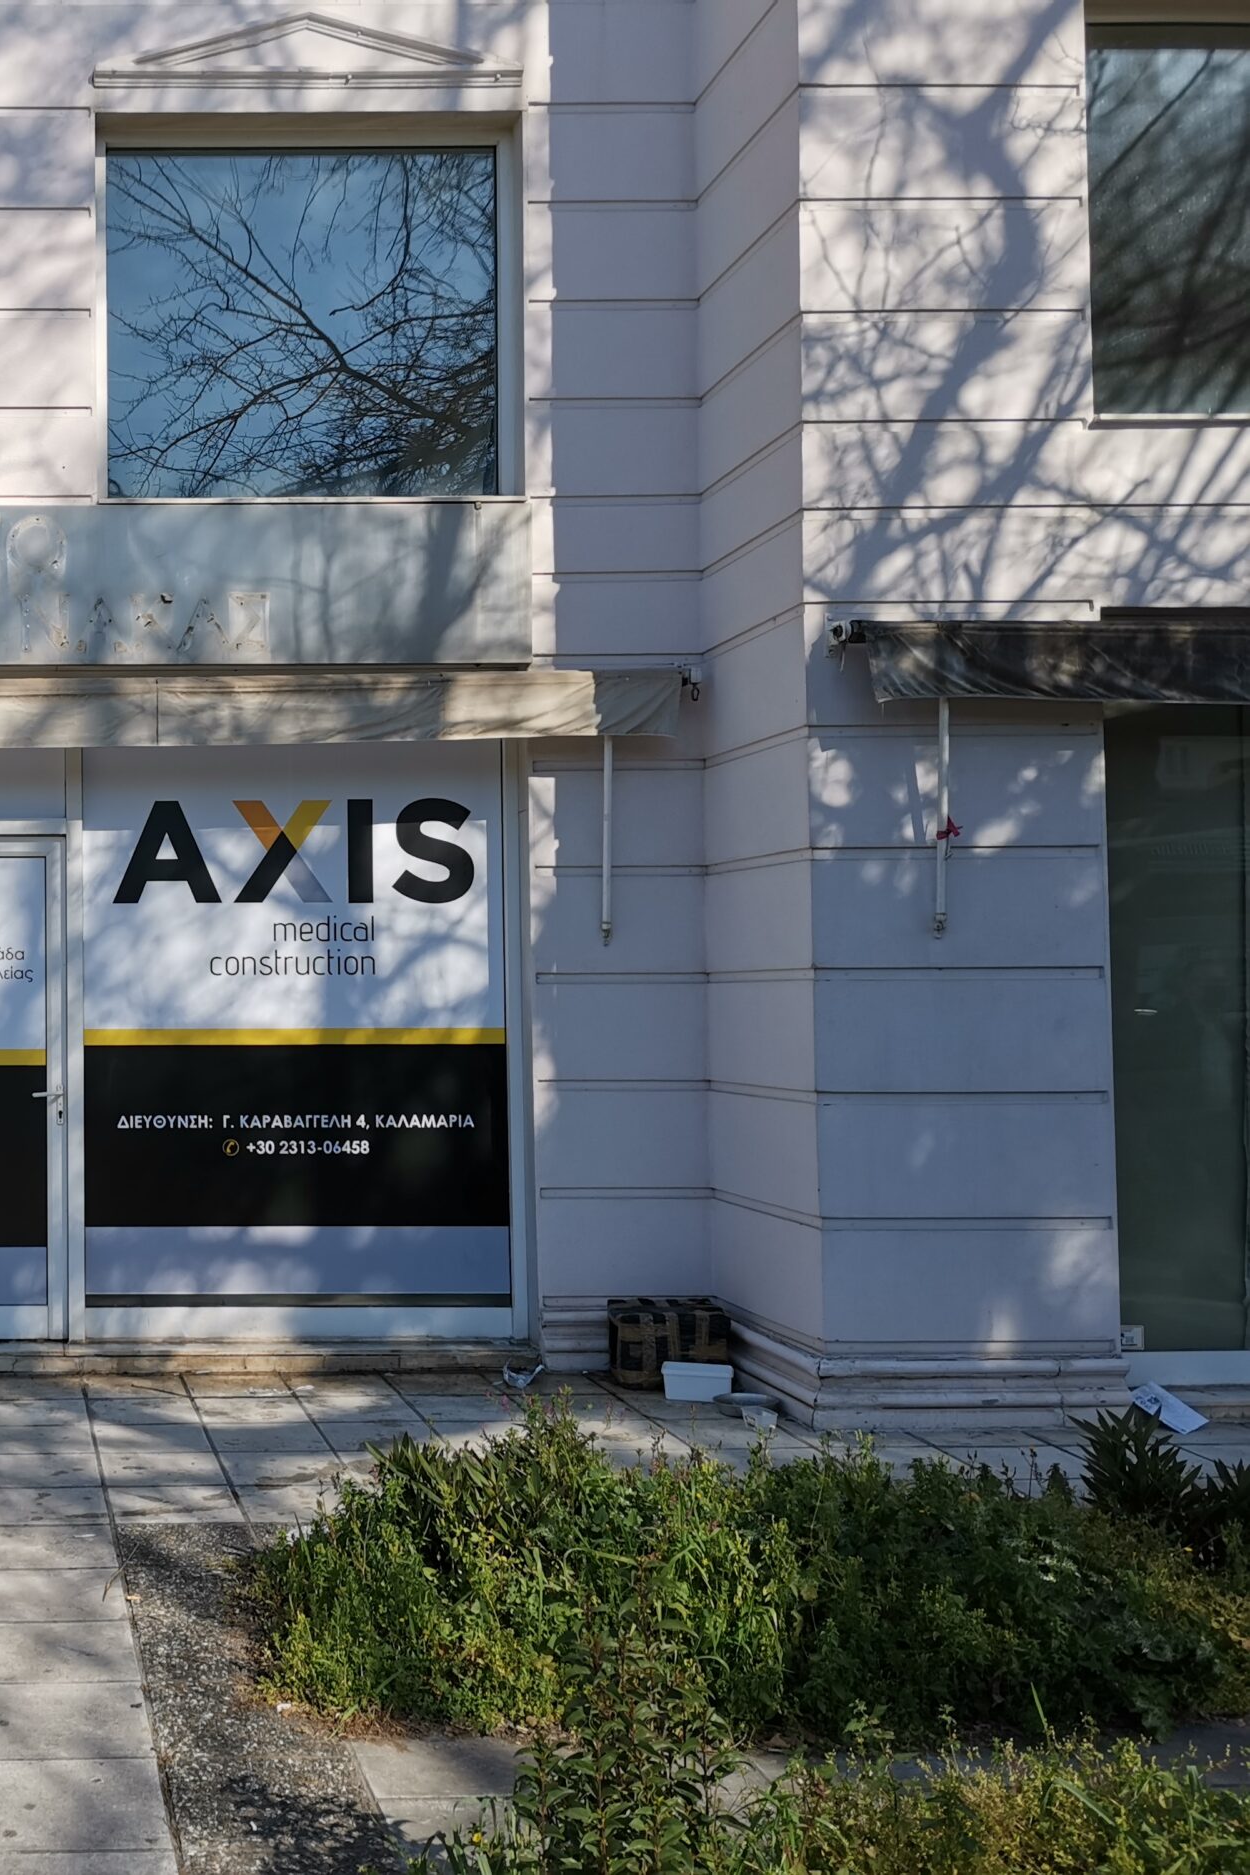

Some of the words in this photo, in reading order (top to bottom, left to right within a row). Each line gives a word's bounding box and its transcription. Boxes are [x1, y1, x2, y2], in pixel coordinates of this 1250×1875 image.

[113, 798, 475, 904] AXIS
[273, 915, 375, 942] medical
[209, 949, 376, 976] construction
[117, 1115, 213, 1129] ΔΙΕΥΘΥΝΣΗ:
[223, 1115, 235, 1129] Γ.
[240, 1114, 351, 1129] ΚΑΡΑΒΑΓΓΕΛΗ
[355, 1114, 370, 1130] 4,
[375, 1114, 475, 1129] ΚΑΛΑΜΑΡΙΑ
[246, 1140, 275, 1155] +30
[279, 1140, 370, 1155] 2313-06458
